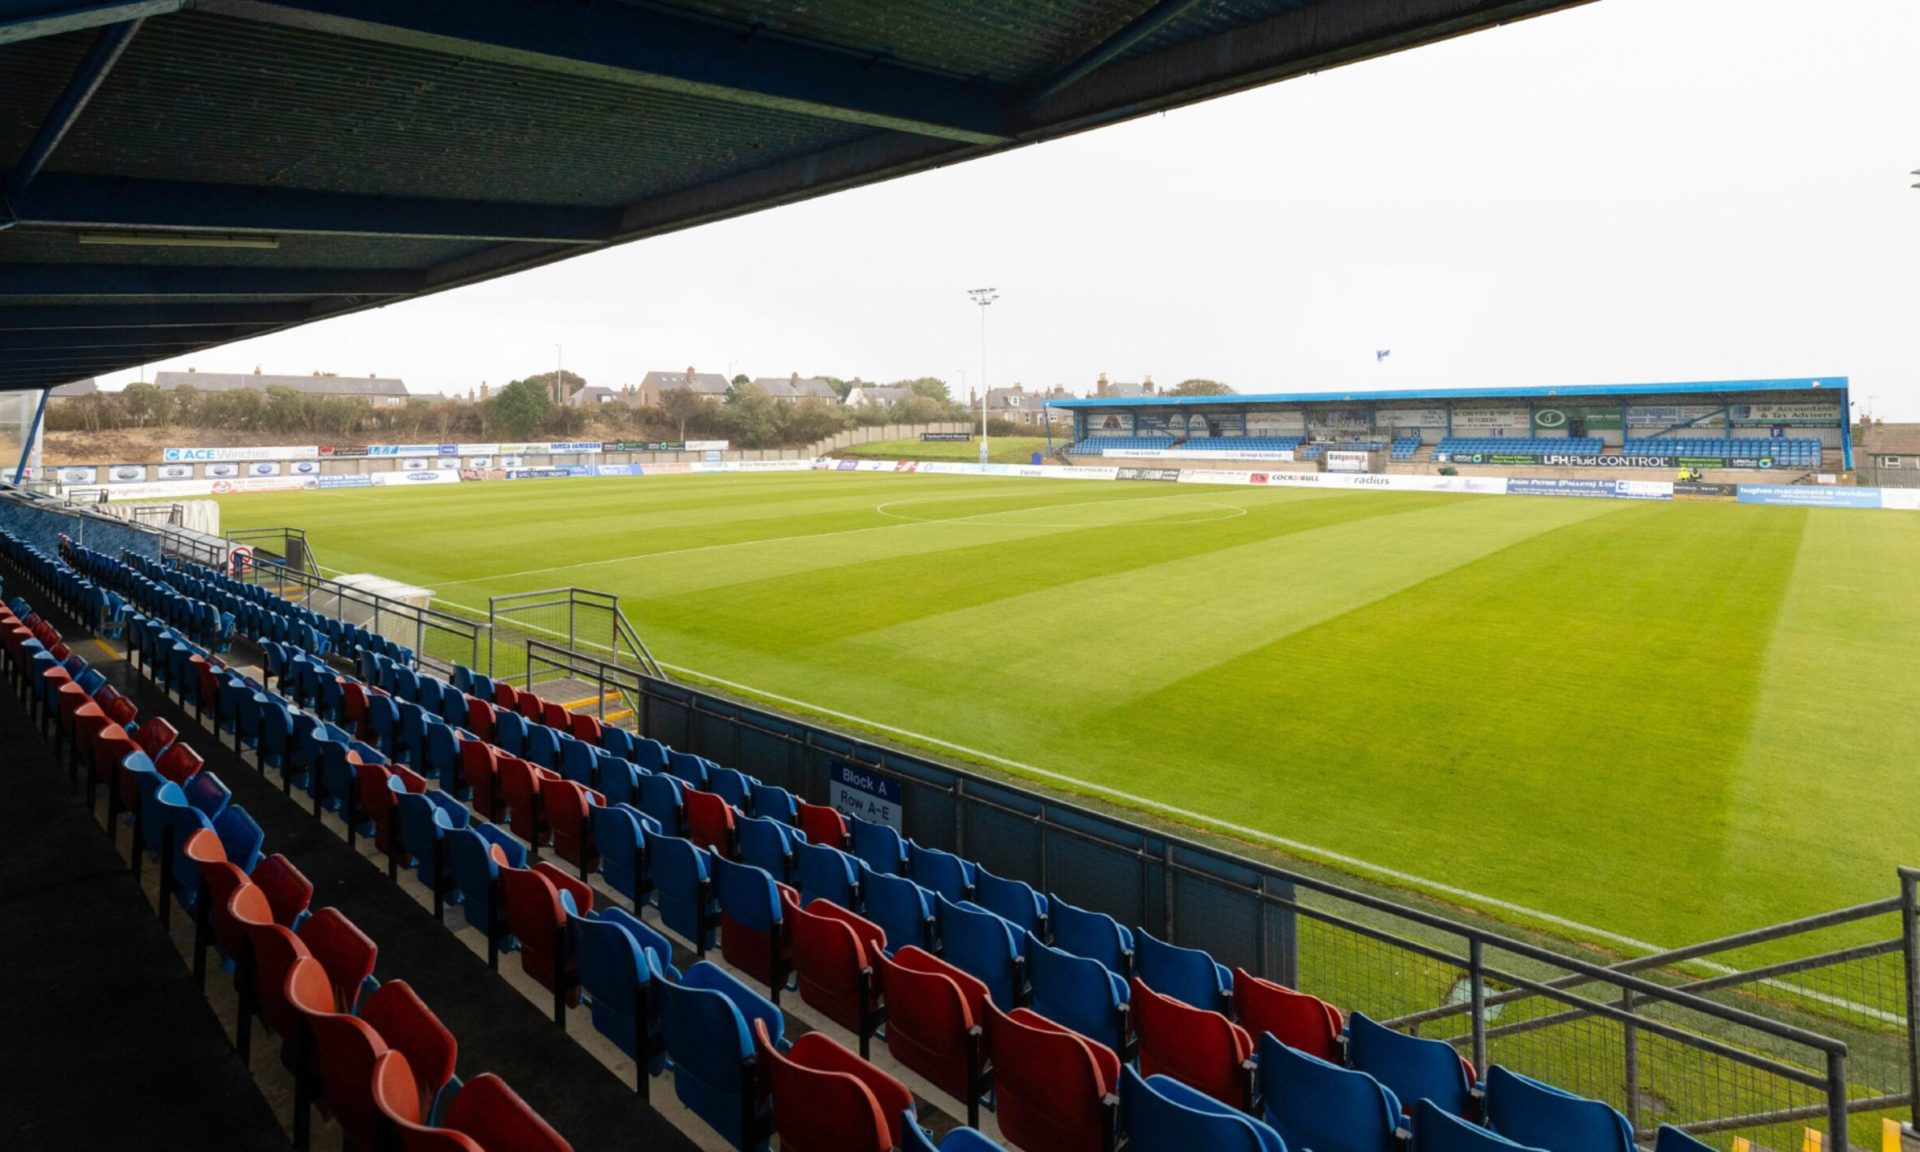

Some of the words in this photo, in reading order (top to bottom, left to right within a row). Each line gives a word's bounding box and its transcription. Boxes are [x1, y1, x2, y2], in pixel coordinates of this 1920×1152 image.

[1773, 429, 1780, 437] F
[184, 449, 215, 459] ACE
[1544, 455, 1568, 465] LFH
[1570, 456, 1597, 465] Fluid
[1598, 456, 1668, 467] CONTROL
[1354, 475, 1390, 485] radius
[1740, 487, 1772, 495] hughes
[1774, 488, 1825, 496] macdonald
[843, 768, 874, 791] Block
[878, 781, 888, 796] A
[840, 790, 864, 809] Row
[868, 801, 890, 820] A-E
